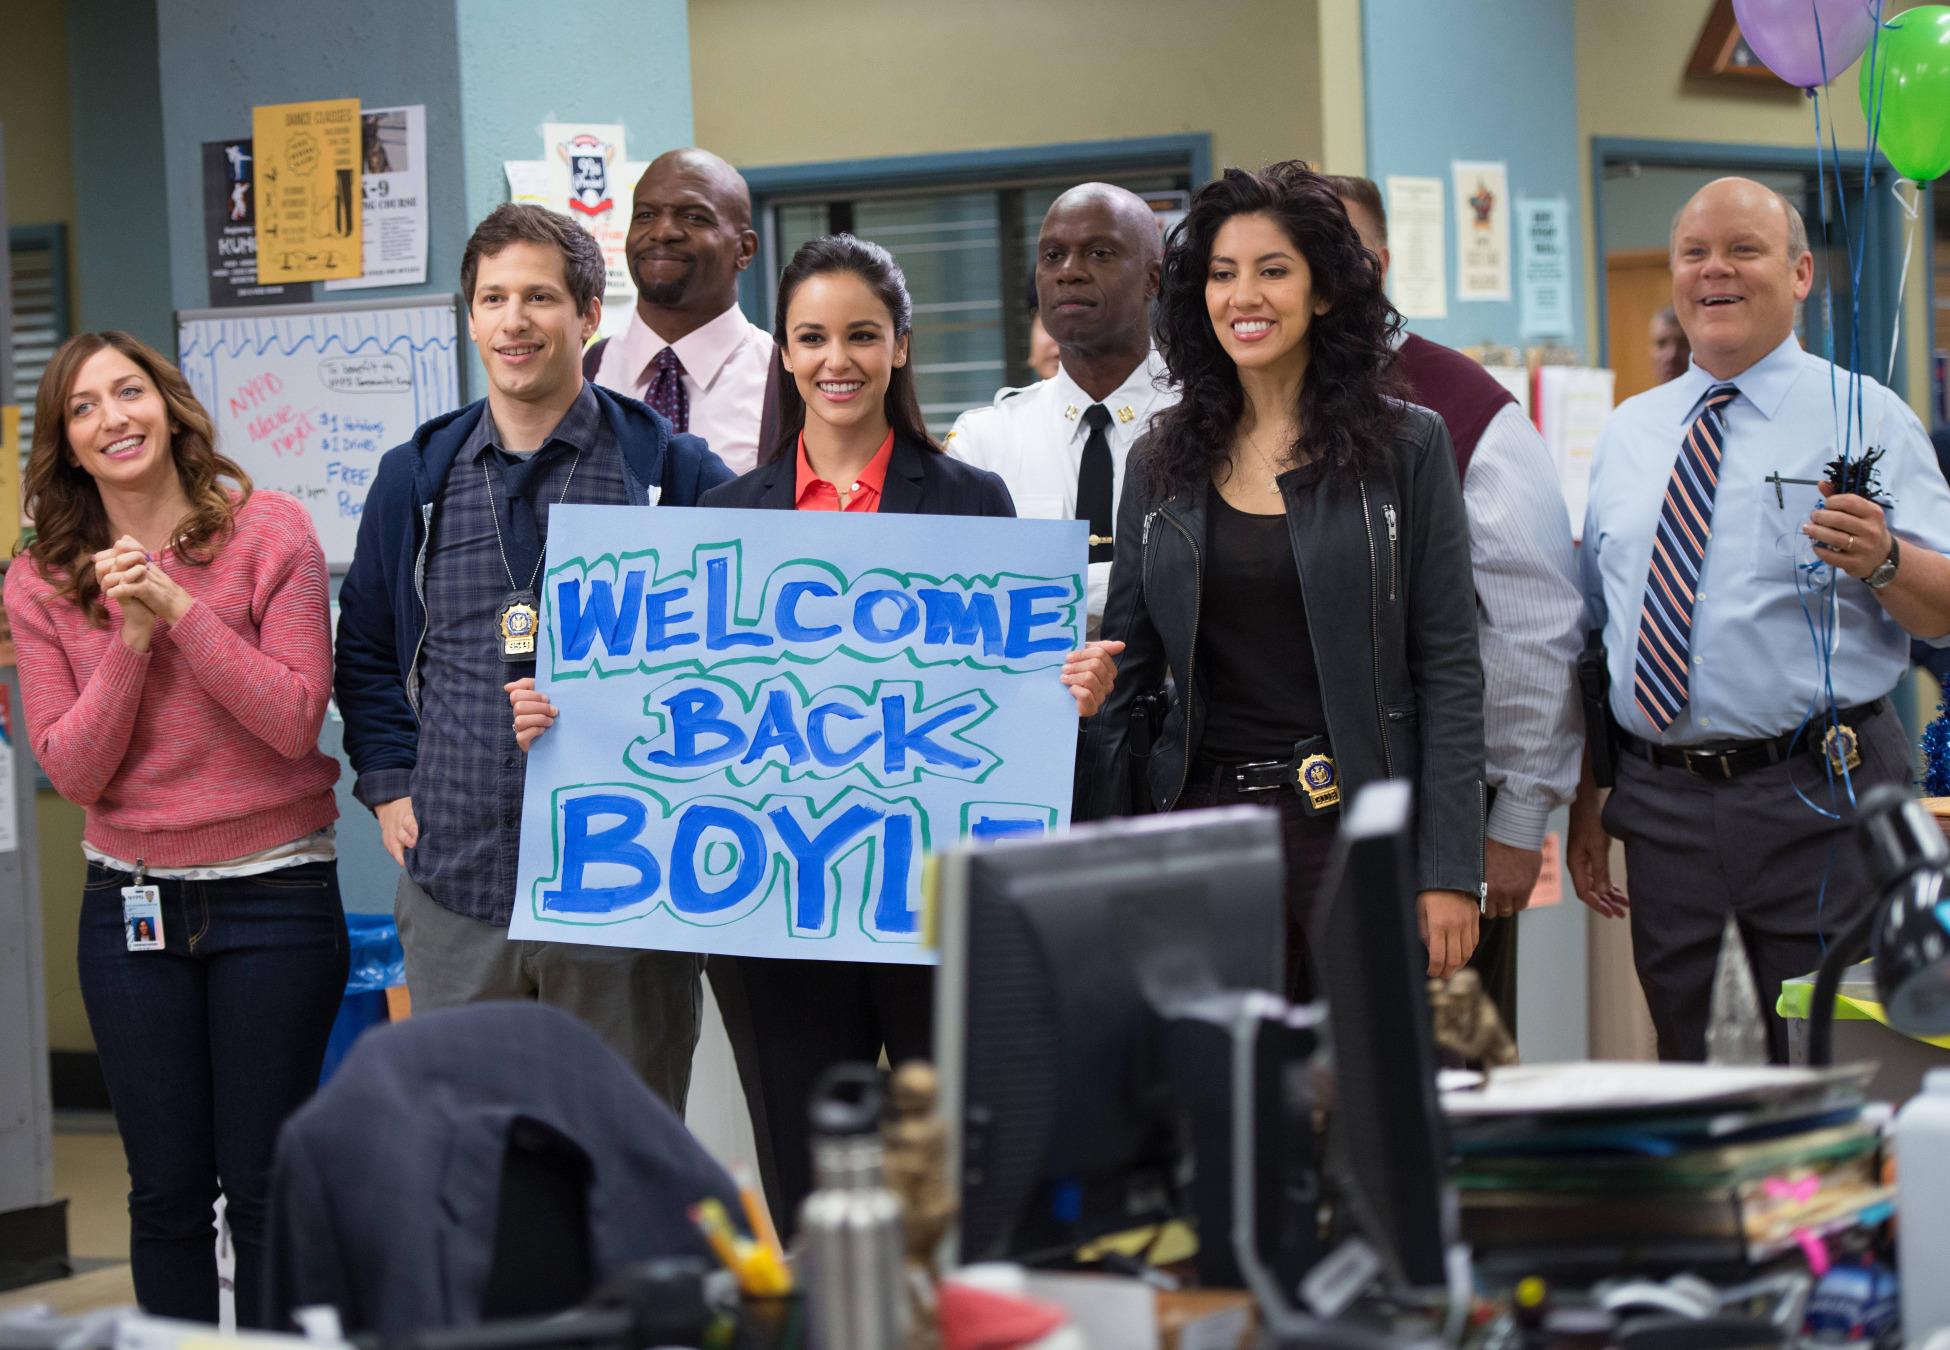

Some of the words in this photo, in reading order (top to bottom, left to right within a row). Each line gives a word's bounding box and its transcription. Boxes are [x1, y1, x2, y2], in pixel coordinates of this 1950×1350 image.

[326, 461, 370, 486] FREE
[557, 556, 1076, 660] WELCOME
[647, 687, 981, 774] BACK
[543, 793, 1045, 933] BOYL
